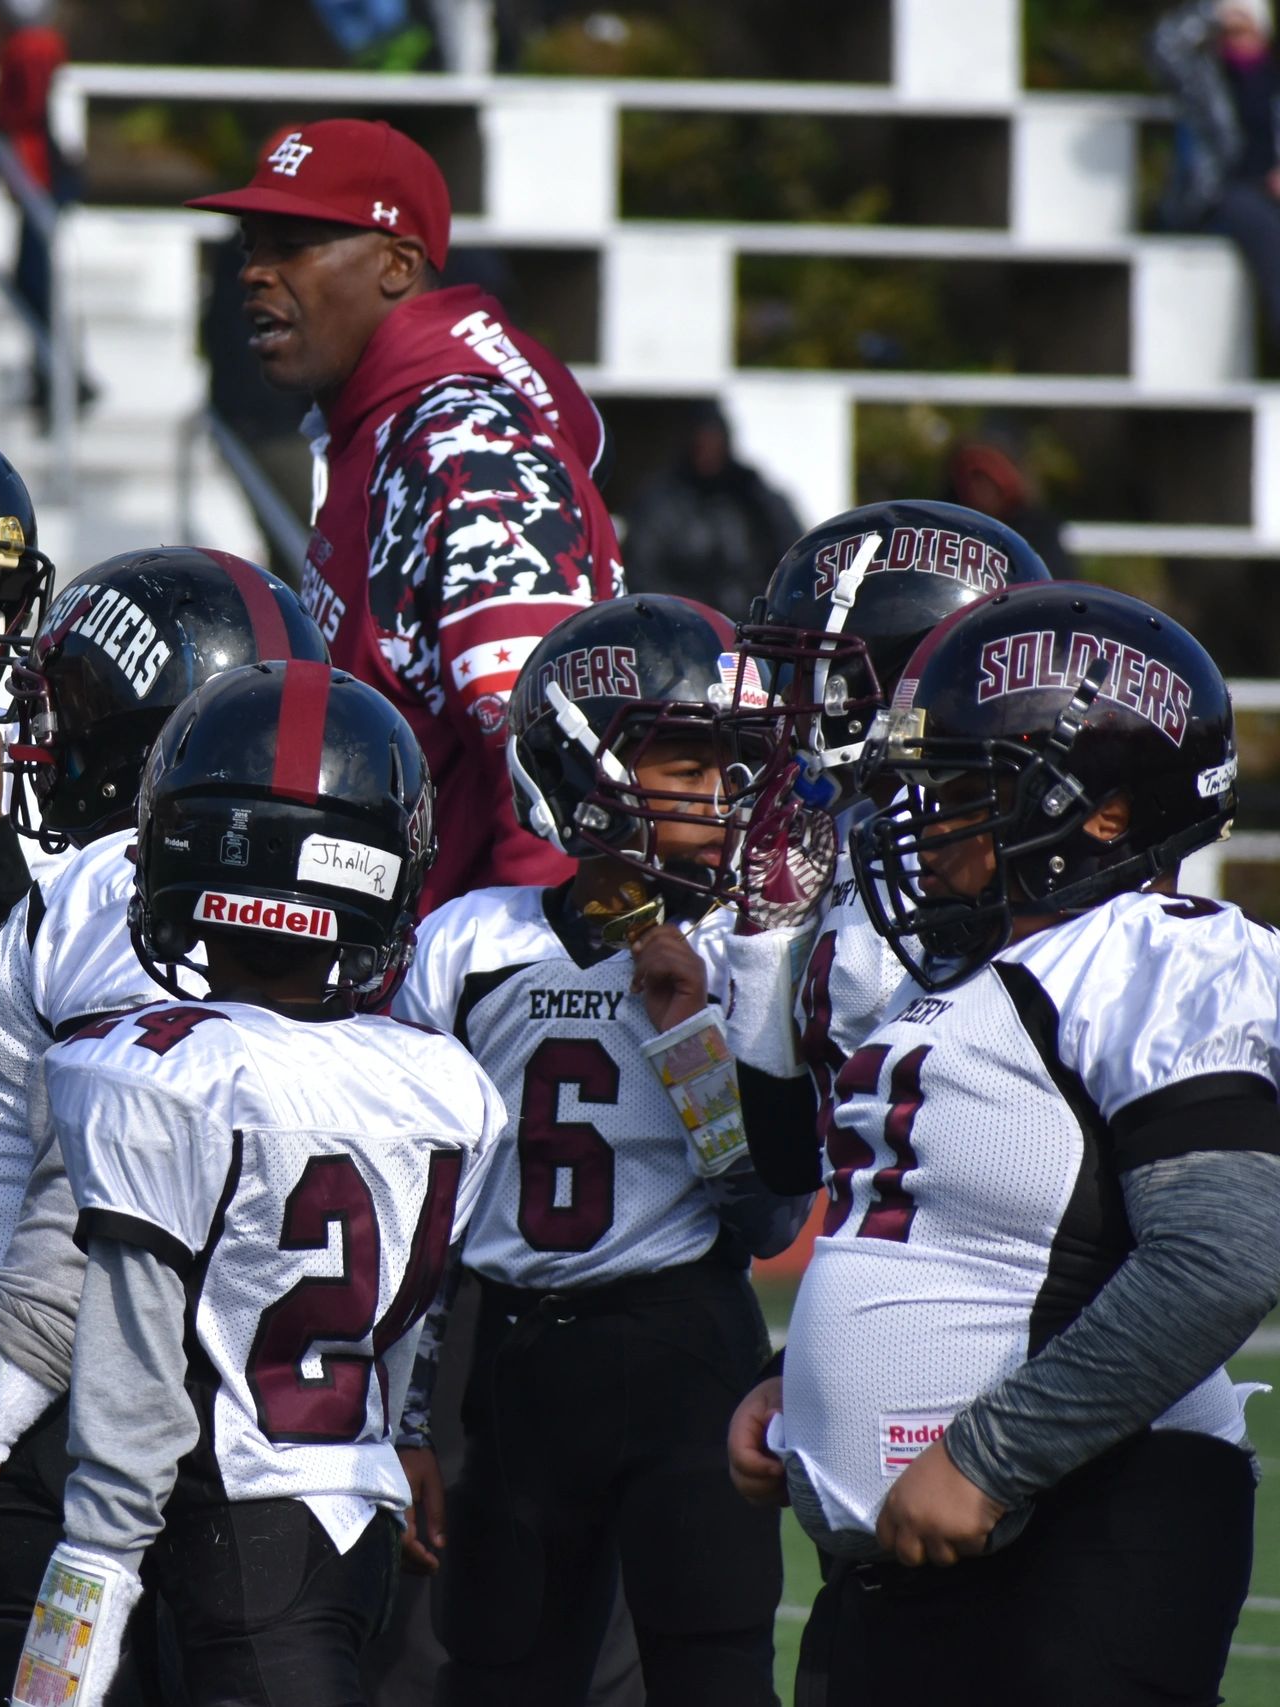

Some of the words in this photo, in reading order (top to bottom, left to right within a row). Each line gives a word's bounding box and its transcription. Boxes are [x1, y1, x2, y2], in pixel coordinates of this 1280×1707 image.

[977, 630, 1193, 749] SOLDIERS
[202, 893, 331, 938] Riddell
[529, 988, 624, 1021] EMERY
[517, 1037, 621, 1253] 6
[889, 1424, 944, 1443] Ridd
